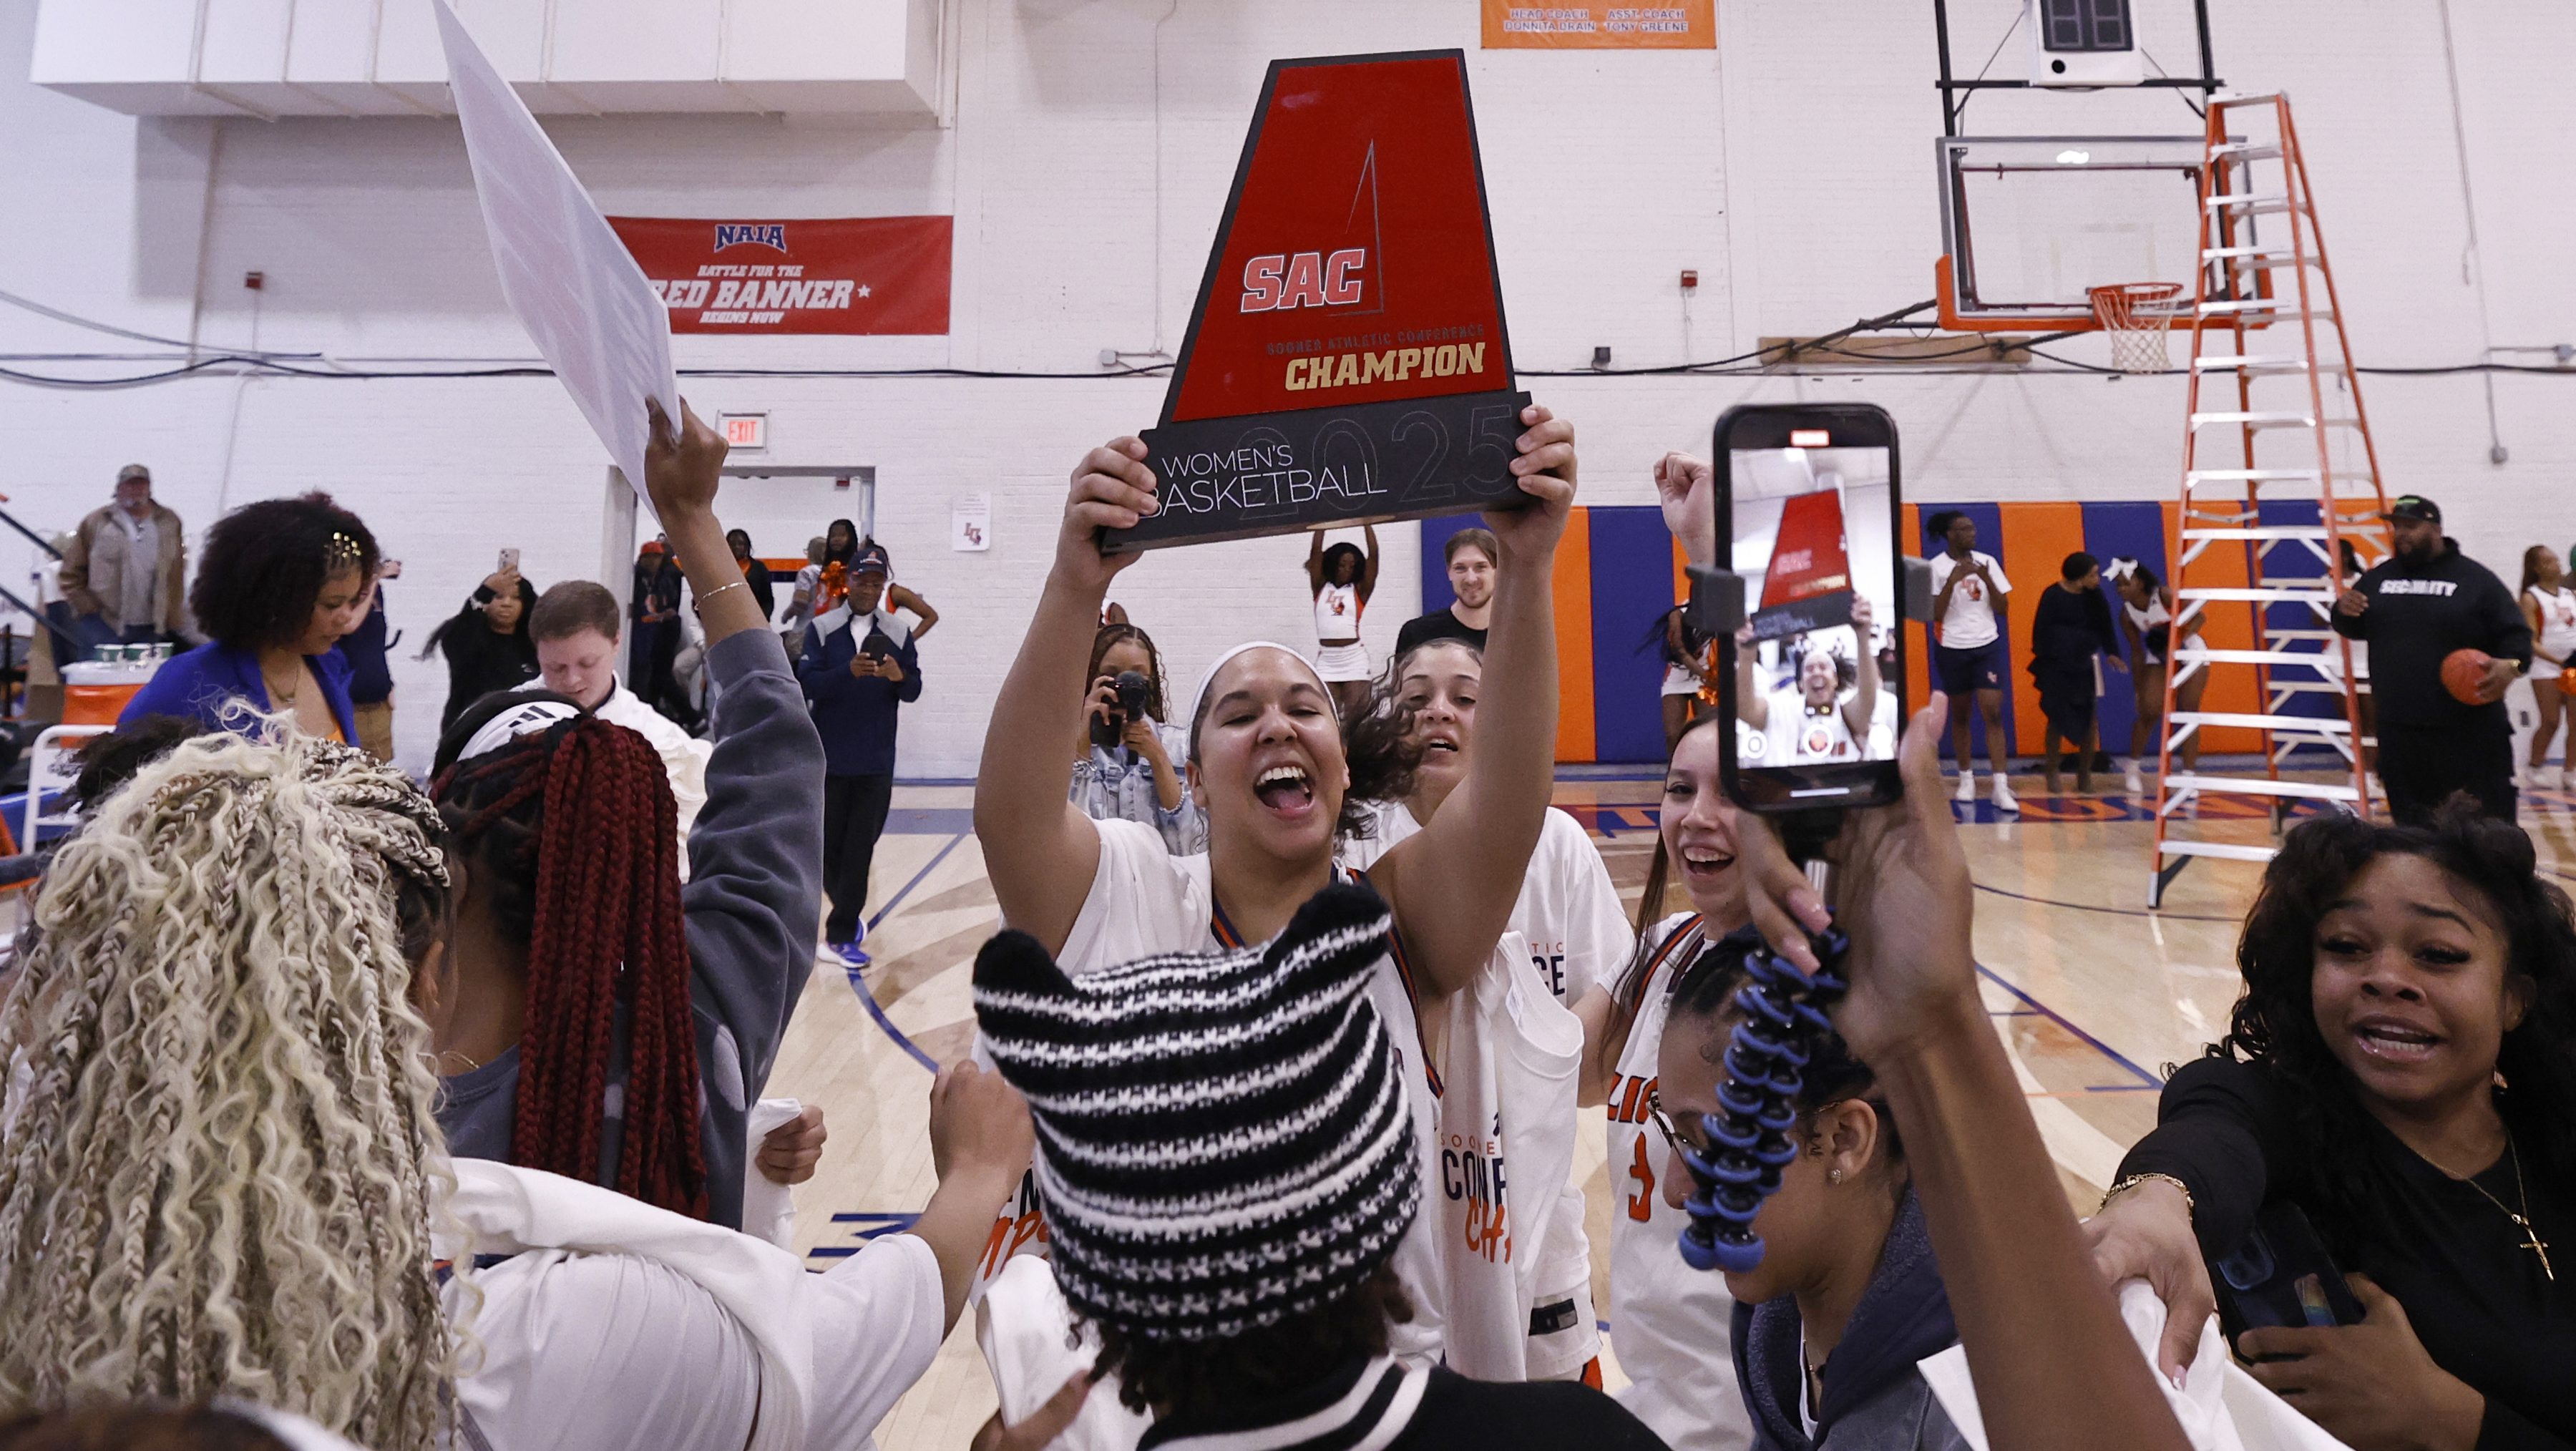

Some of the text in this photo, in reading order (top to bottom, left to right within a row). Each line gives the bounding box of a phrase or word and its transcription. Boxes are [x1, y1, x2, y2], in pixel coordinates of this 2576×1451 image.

[1546, 9, 1589, 19] COACH
[1605, 21, 1637, 31] TONY
[1641, 9, 1685, 19] COACH
[714, 224, 786, 253] NAIA
[697, 265, 804, 277] BATTLE FOR THE
[1241, 248, 1365, 313] SAC
[711, 280, 855, 309] BANNER
[699, 311, 786, 323] BEGINS NOW
[1267, 324, 1485, 356] SOONER ATHLETIC CONFERENCE
[1285, 342, 1486, 391] CHAMPION
[728, 420, 756, 442] EXIT
[1161, 444, 1294, 479] WOMEN'S
[1235, 404, 1513, 520] 2025
